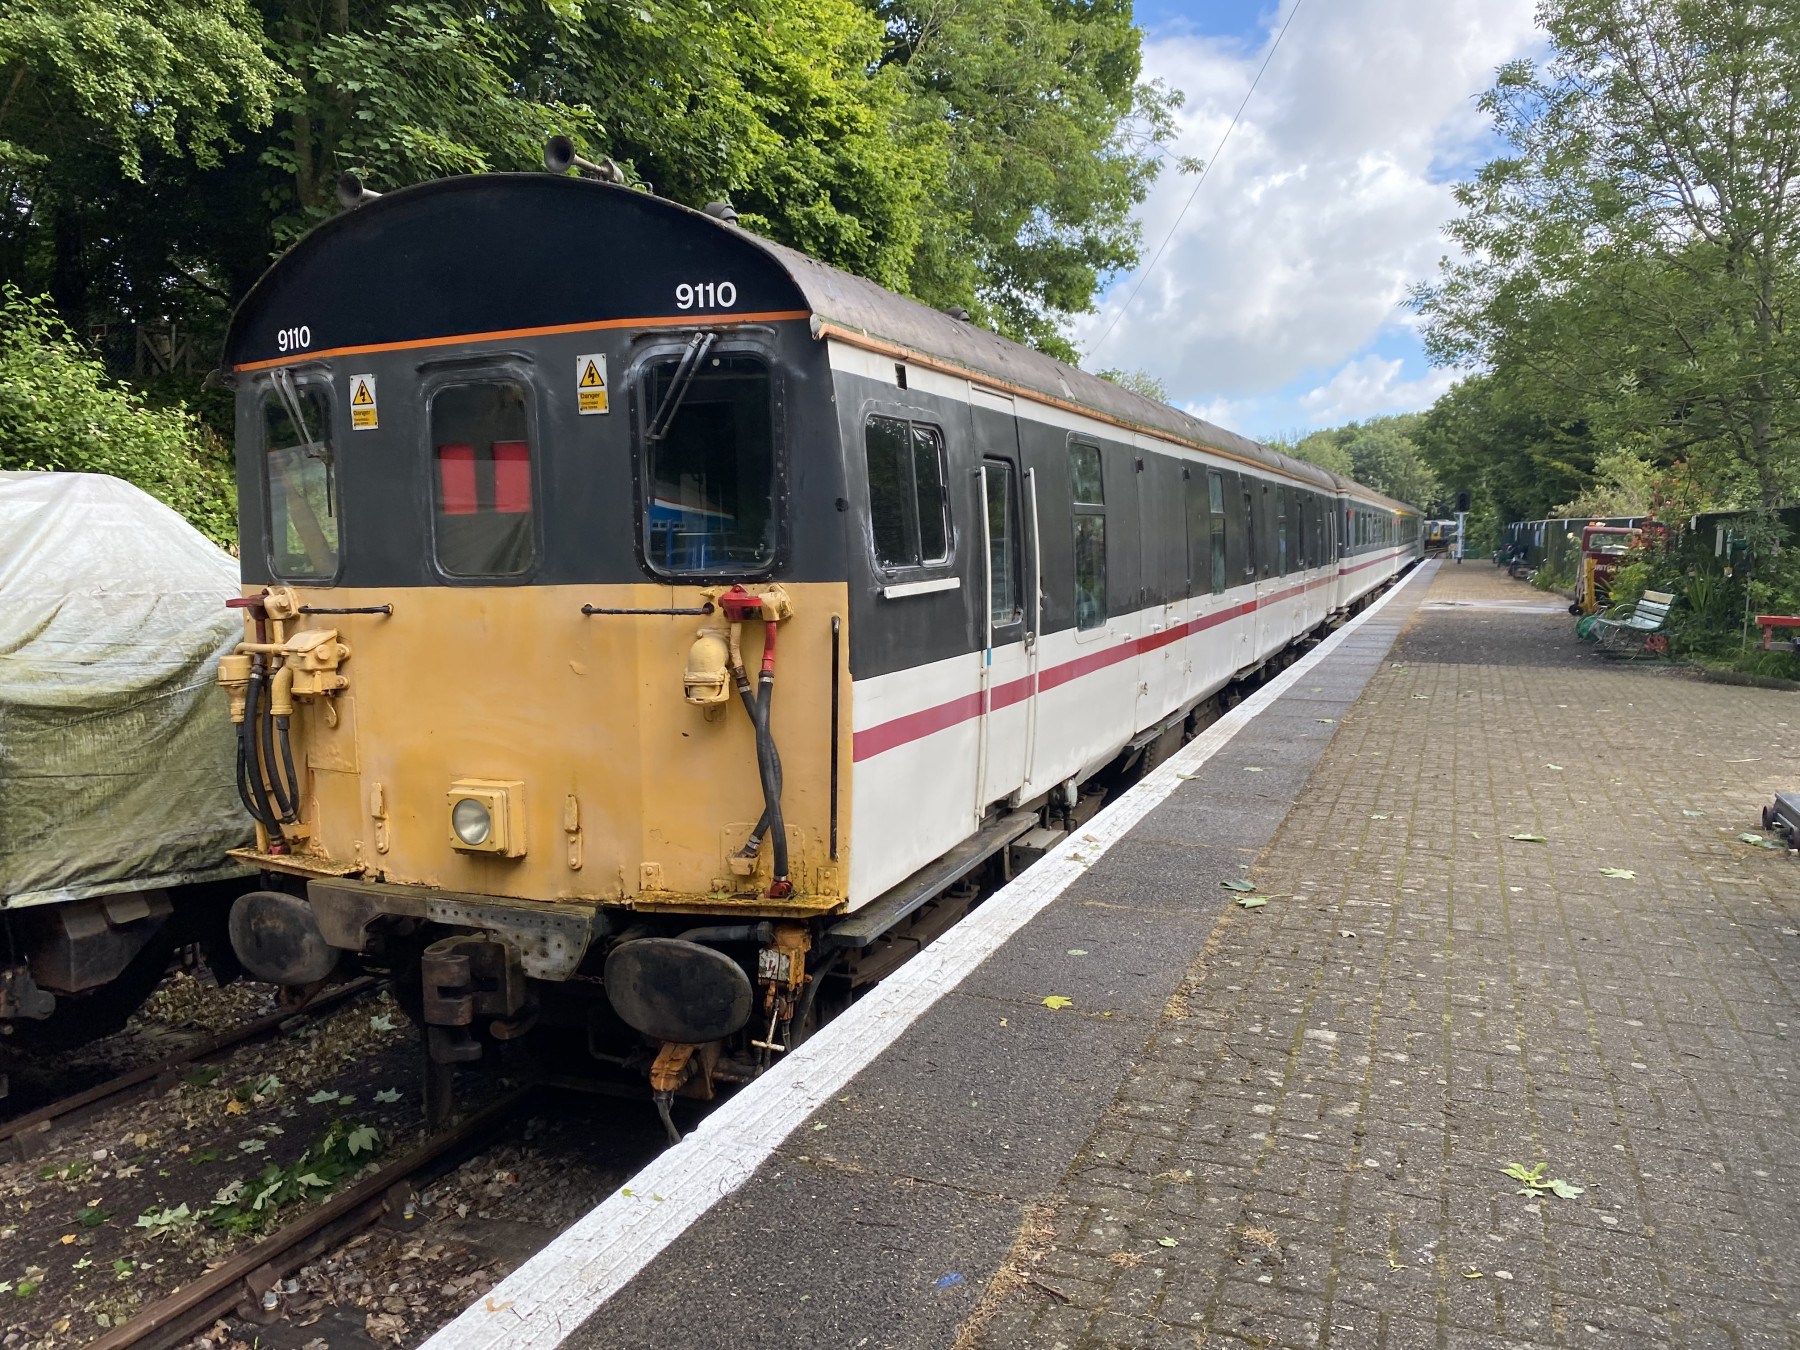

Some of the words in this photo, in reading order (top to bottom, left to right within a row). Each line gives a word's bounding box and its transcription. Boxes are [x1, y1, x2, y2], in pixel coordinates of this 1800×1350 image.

[675, 281, 737, 310] 9110
[277, 325, 311, 351] 9110
[580, 392, 600, 400] Danger
